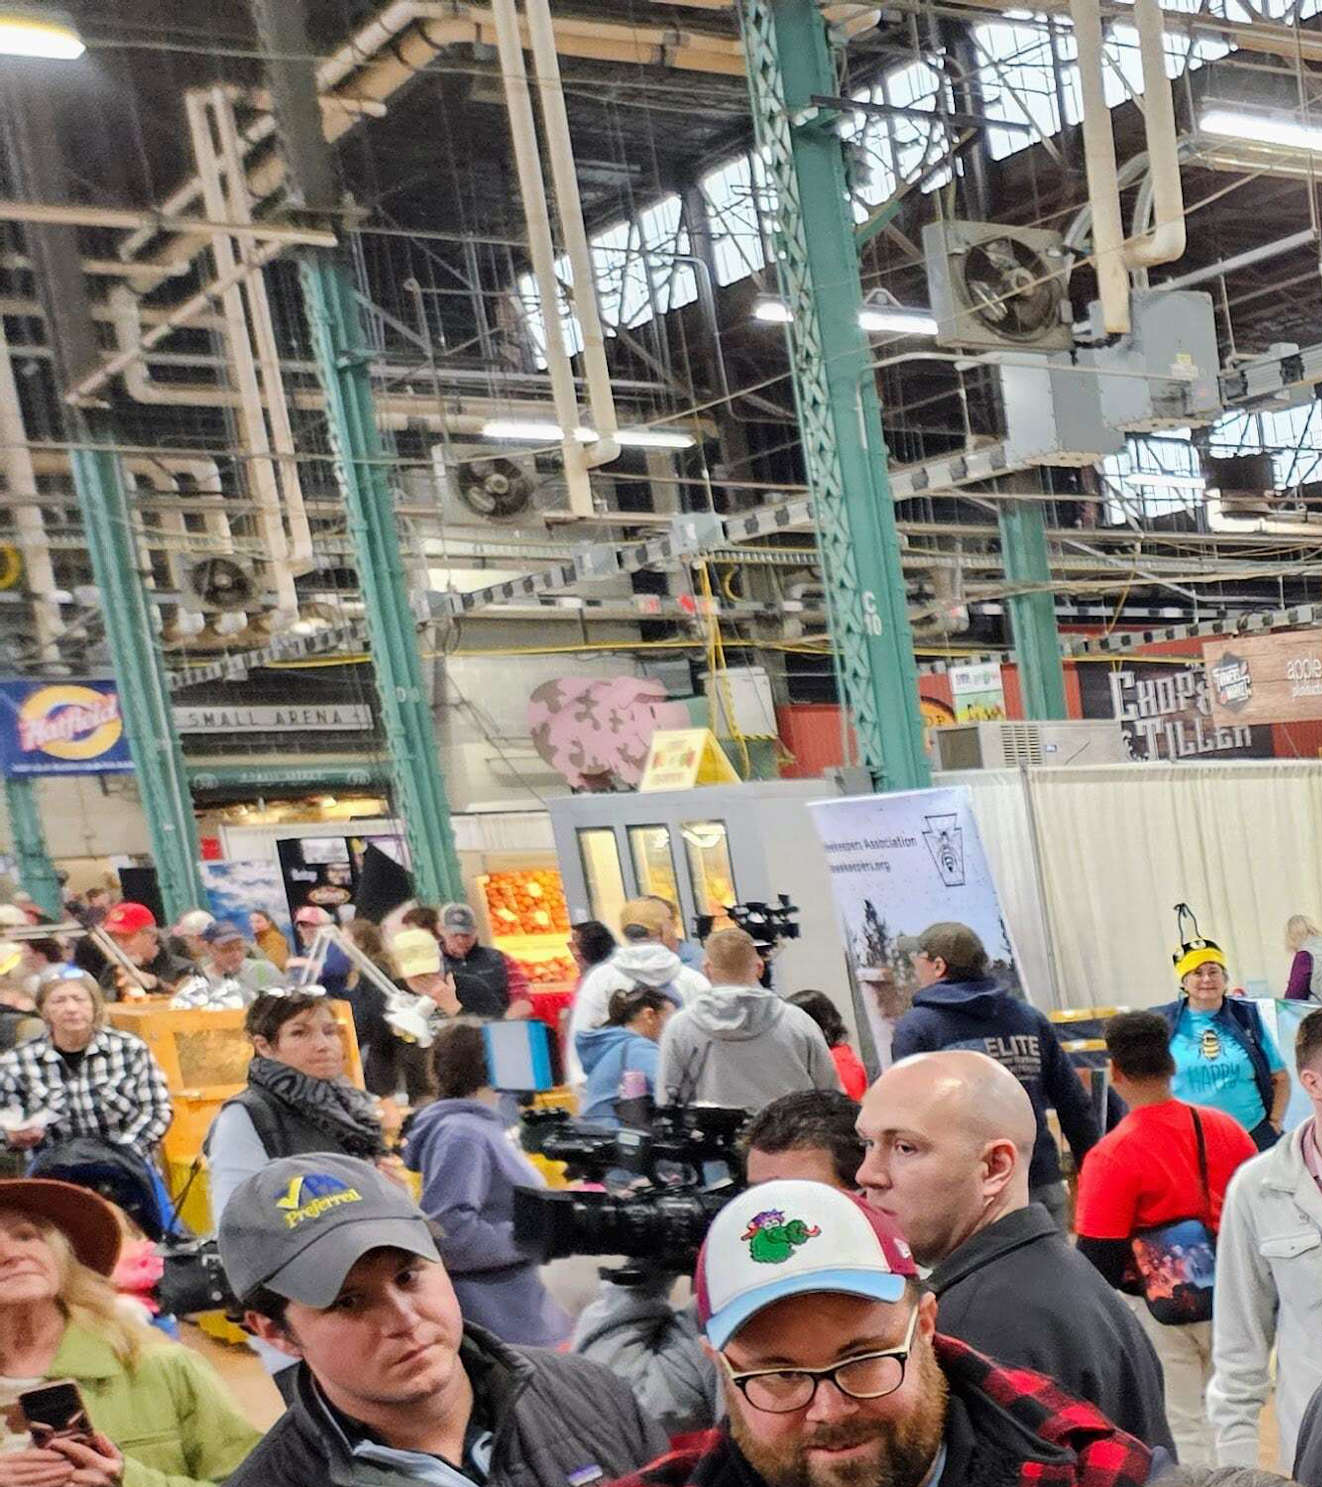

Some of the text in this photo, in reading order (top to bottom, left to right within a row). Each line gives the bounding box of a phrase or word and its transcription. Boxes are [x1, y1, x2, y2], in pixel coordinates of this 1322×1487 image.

[188, 708, 343, 727] SMALL ARENA
[984, 1035, 1041, 1057] ELITE
[1187, 1063, 1240, 1093] HAPPY
[284, 1188, 363, 1229] Preferred
